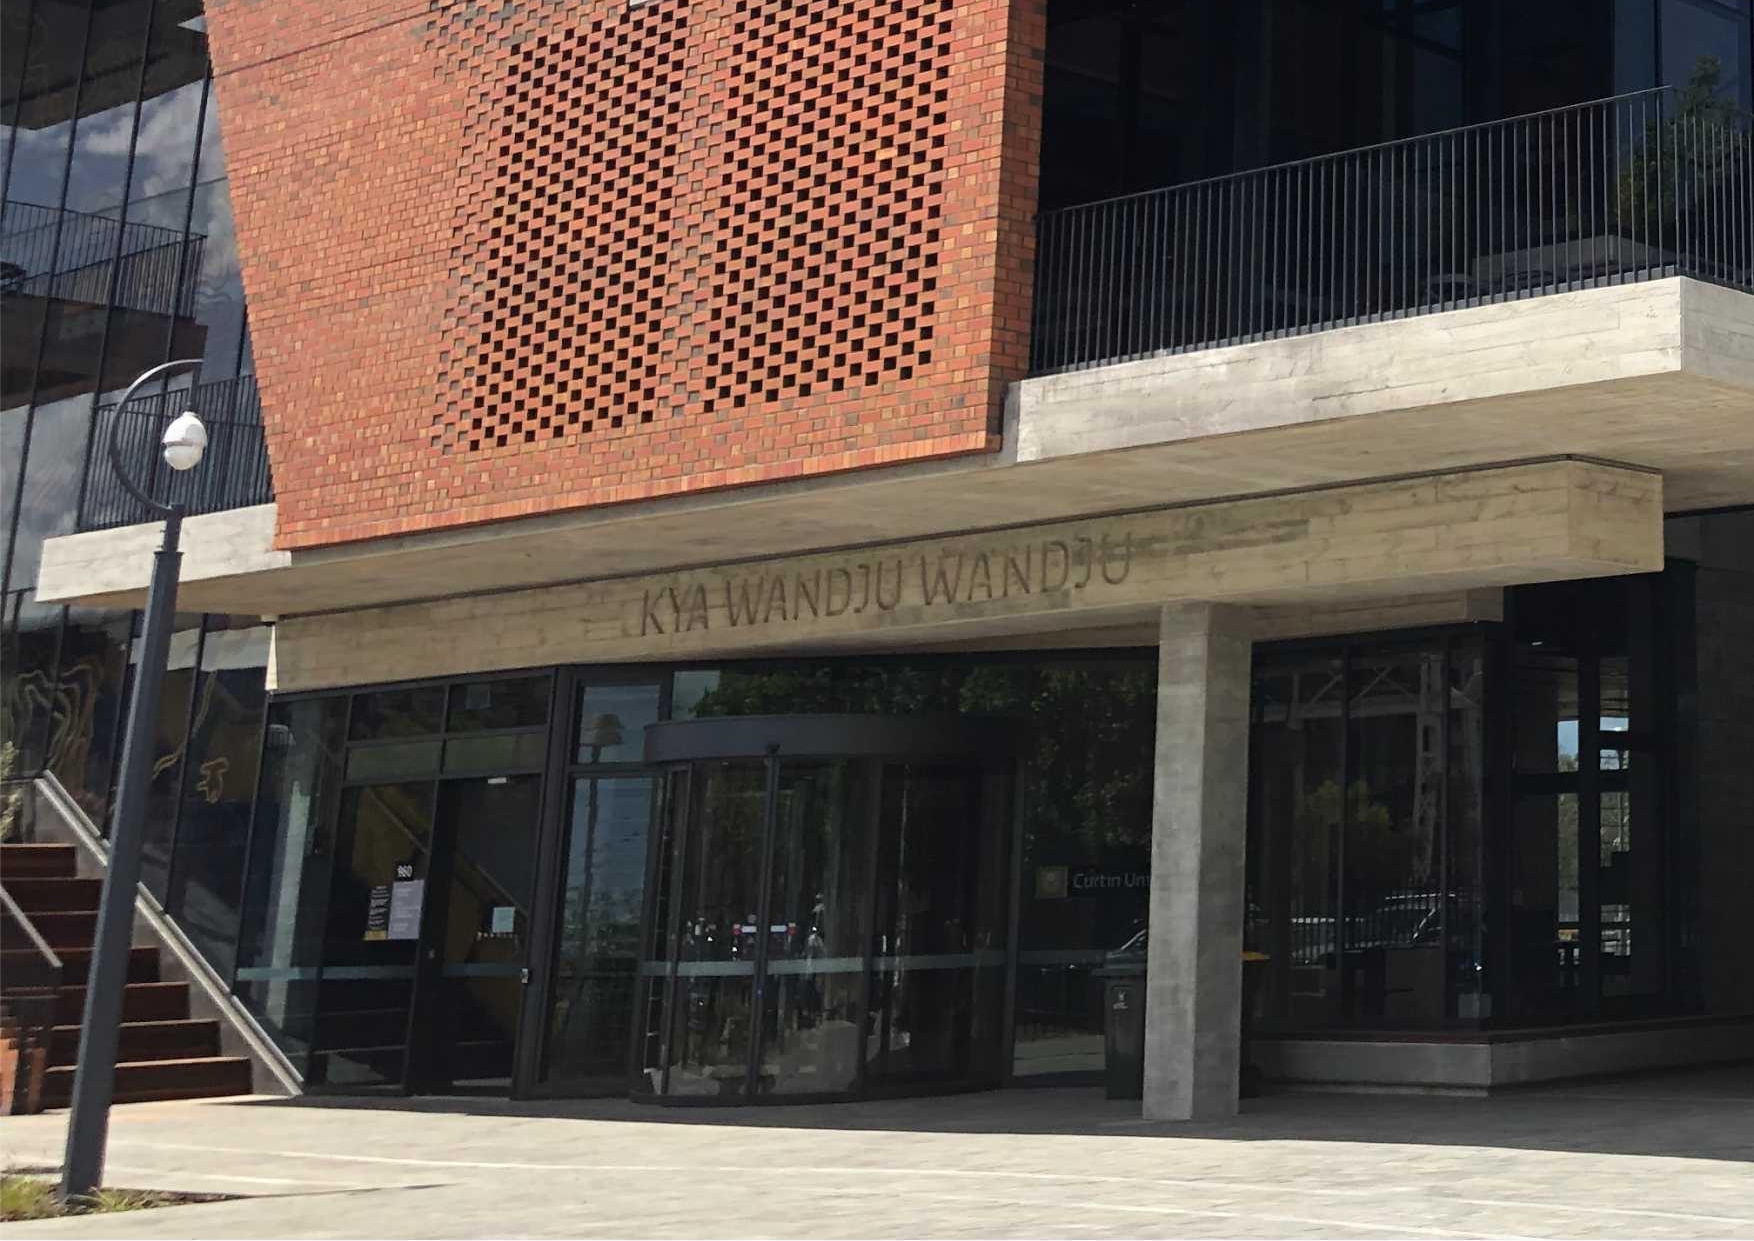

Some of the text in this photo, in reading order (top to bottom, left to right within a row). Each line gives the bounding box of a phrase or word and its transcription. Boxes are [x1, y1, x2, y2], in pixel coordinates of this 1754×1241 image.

[641, 534, 1130, 636] KYA WANDJU WANDJU
[1073, 872, 1121, 888] Curtin
